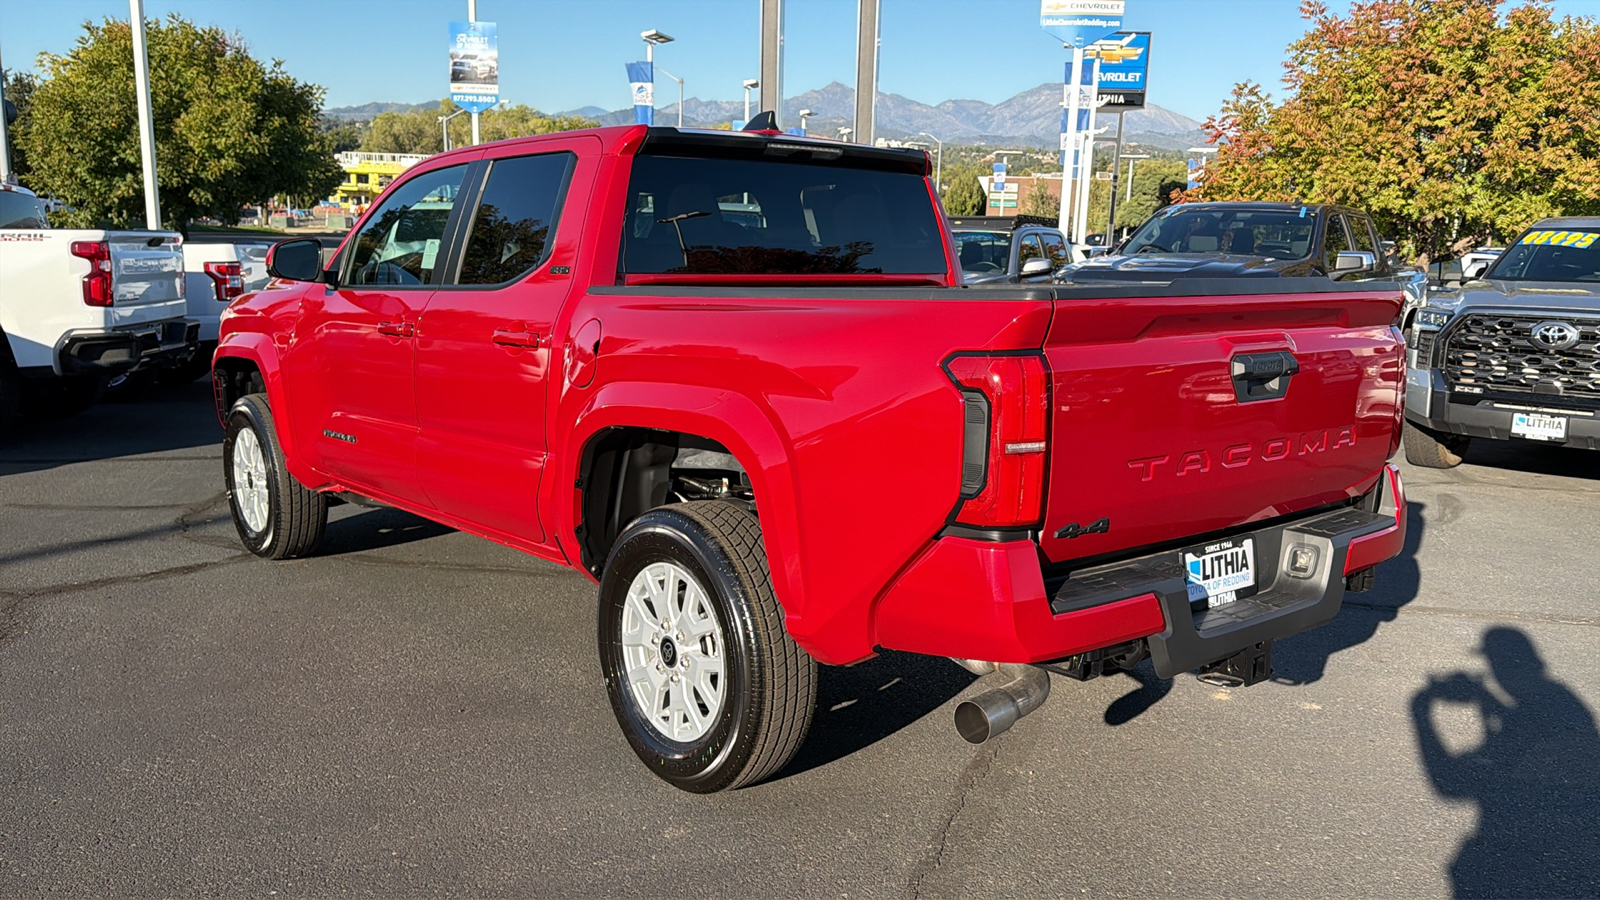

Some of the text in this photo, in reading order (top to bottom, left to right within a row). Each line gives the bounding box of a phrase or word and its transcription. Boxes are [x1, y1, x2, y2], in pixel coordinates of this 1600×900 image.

[1070, 2, 1121, 11] CHEVROLET
[1043, 18, 1121, 28] LithiaChevroletRedding.com
[1098, 94, 1125, 104] ITHIA
[1522, 231, 1600, 247] 48495
[1253, 360, 1281, 372] TOYOTA
[1526, 418, 1563, 431] LITHIA
[1127, 425, 1357, 481] TACOMA
[1204, 543, 1221, 553] SINCE
[1202, 549, 1249, 581] LITHIA
[1187, 571, 1250, 596] TOYOTA OF REDDING
